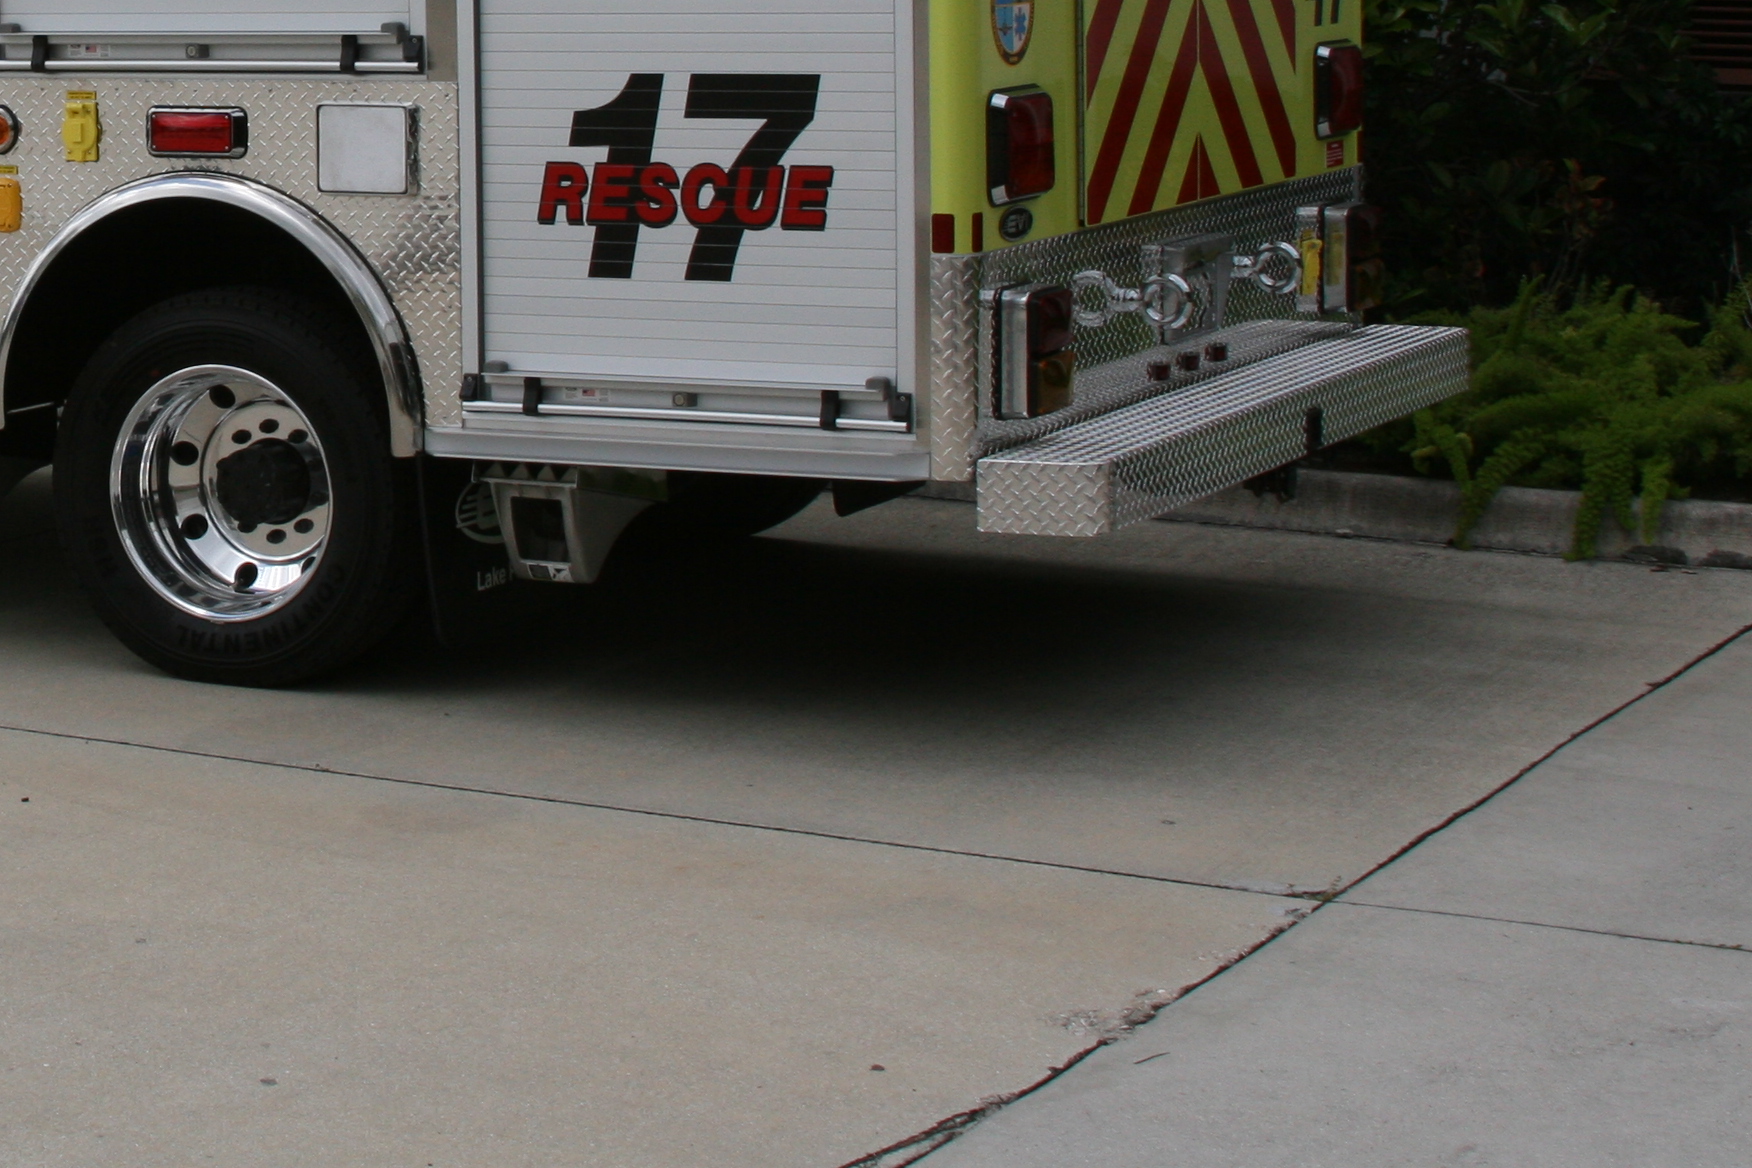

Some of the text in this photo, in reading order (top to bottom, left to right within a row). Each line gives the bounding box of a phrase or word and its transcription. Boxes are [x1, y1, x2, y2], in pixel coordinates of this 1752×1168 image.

[537, 161, 835, 231] RESCUE
[568, 73, 821, 282] 17
[175, 563, 346, 655] CONTINENTAL
[476, 566, 507, 592] Lake
